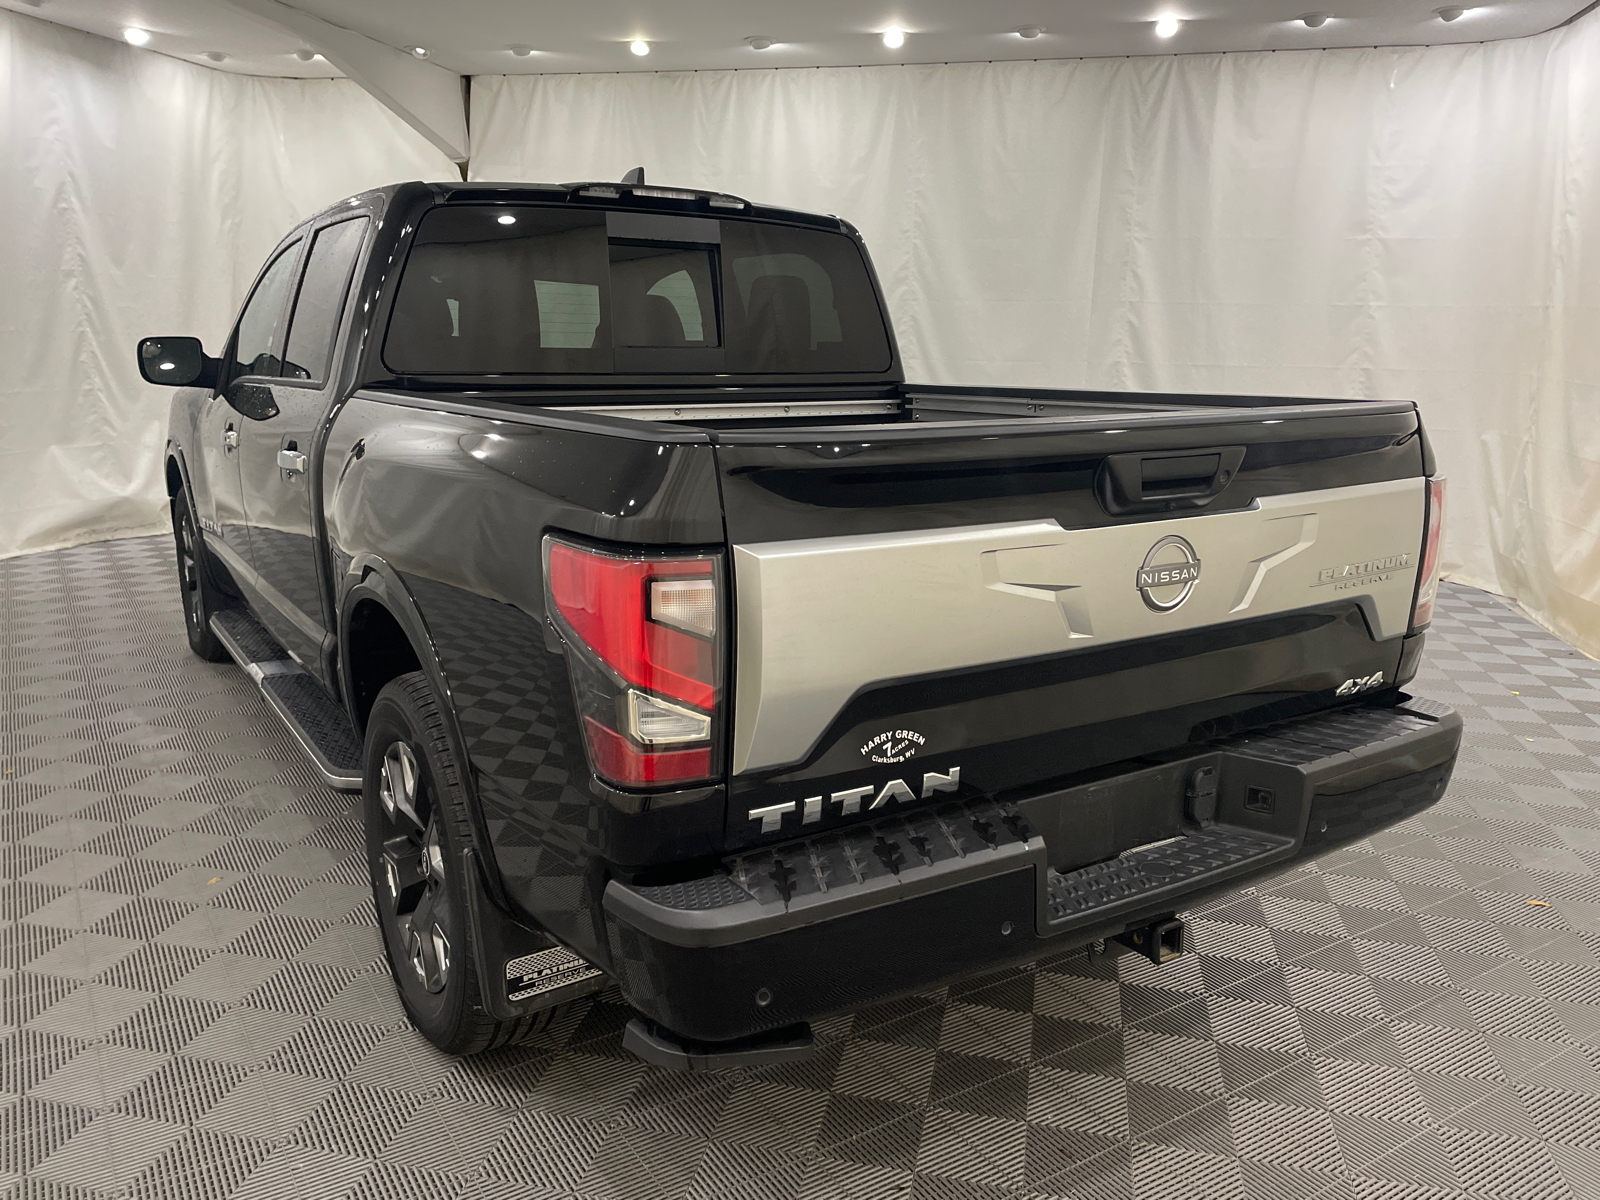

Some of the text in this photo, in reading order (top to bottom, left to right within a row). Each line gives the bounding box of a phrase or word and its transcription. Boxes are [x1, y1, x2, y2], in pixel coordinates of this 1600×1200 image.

[1141, 567, 1197, 584] NISSAN
[1318, 553, 1411, 581] PLATINUM
[860, 730, 926, 755] HARRY GREEN
[882, 739, 909, 757] 7 ACRES
[871, 747, 915, 764] Clarksburg, WV
[749, 767, 960, 834] TITAN
[523, 958, 587, 982] PLATINU
